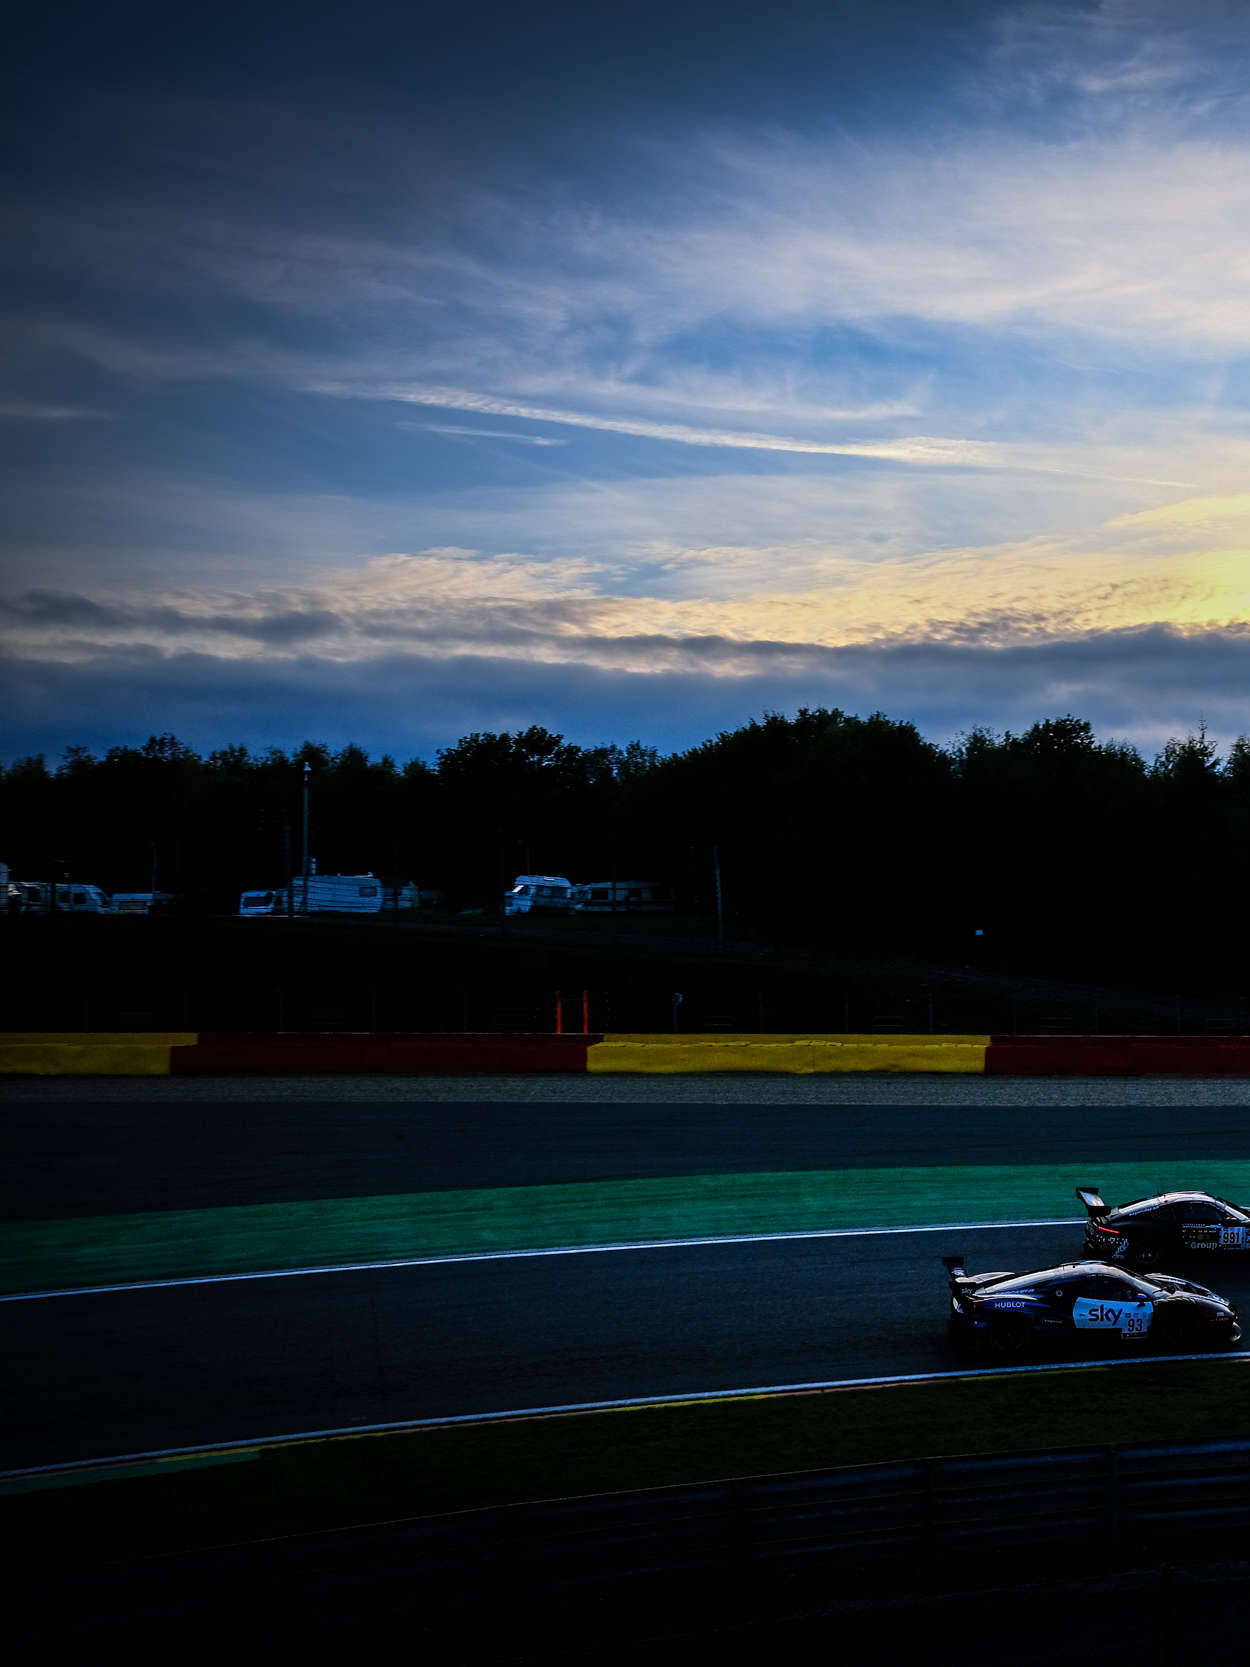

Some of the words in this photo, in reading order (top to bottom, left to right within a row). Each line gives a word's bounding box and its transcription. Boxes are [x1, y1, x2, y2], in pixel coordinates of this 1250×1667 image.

[1223, 1232, 1239, 1243] 991
[1190, 1241, 1218, 1250] Group
[961, 1287, 973, 1295] sky
[1088, 1304, 1123, 1326] sky
[1128, 1318, 1143, 1332] 93
